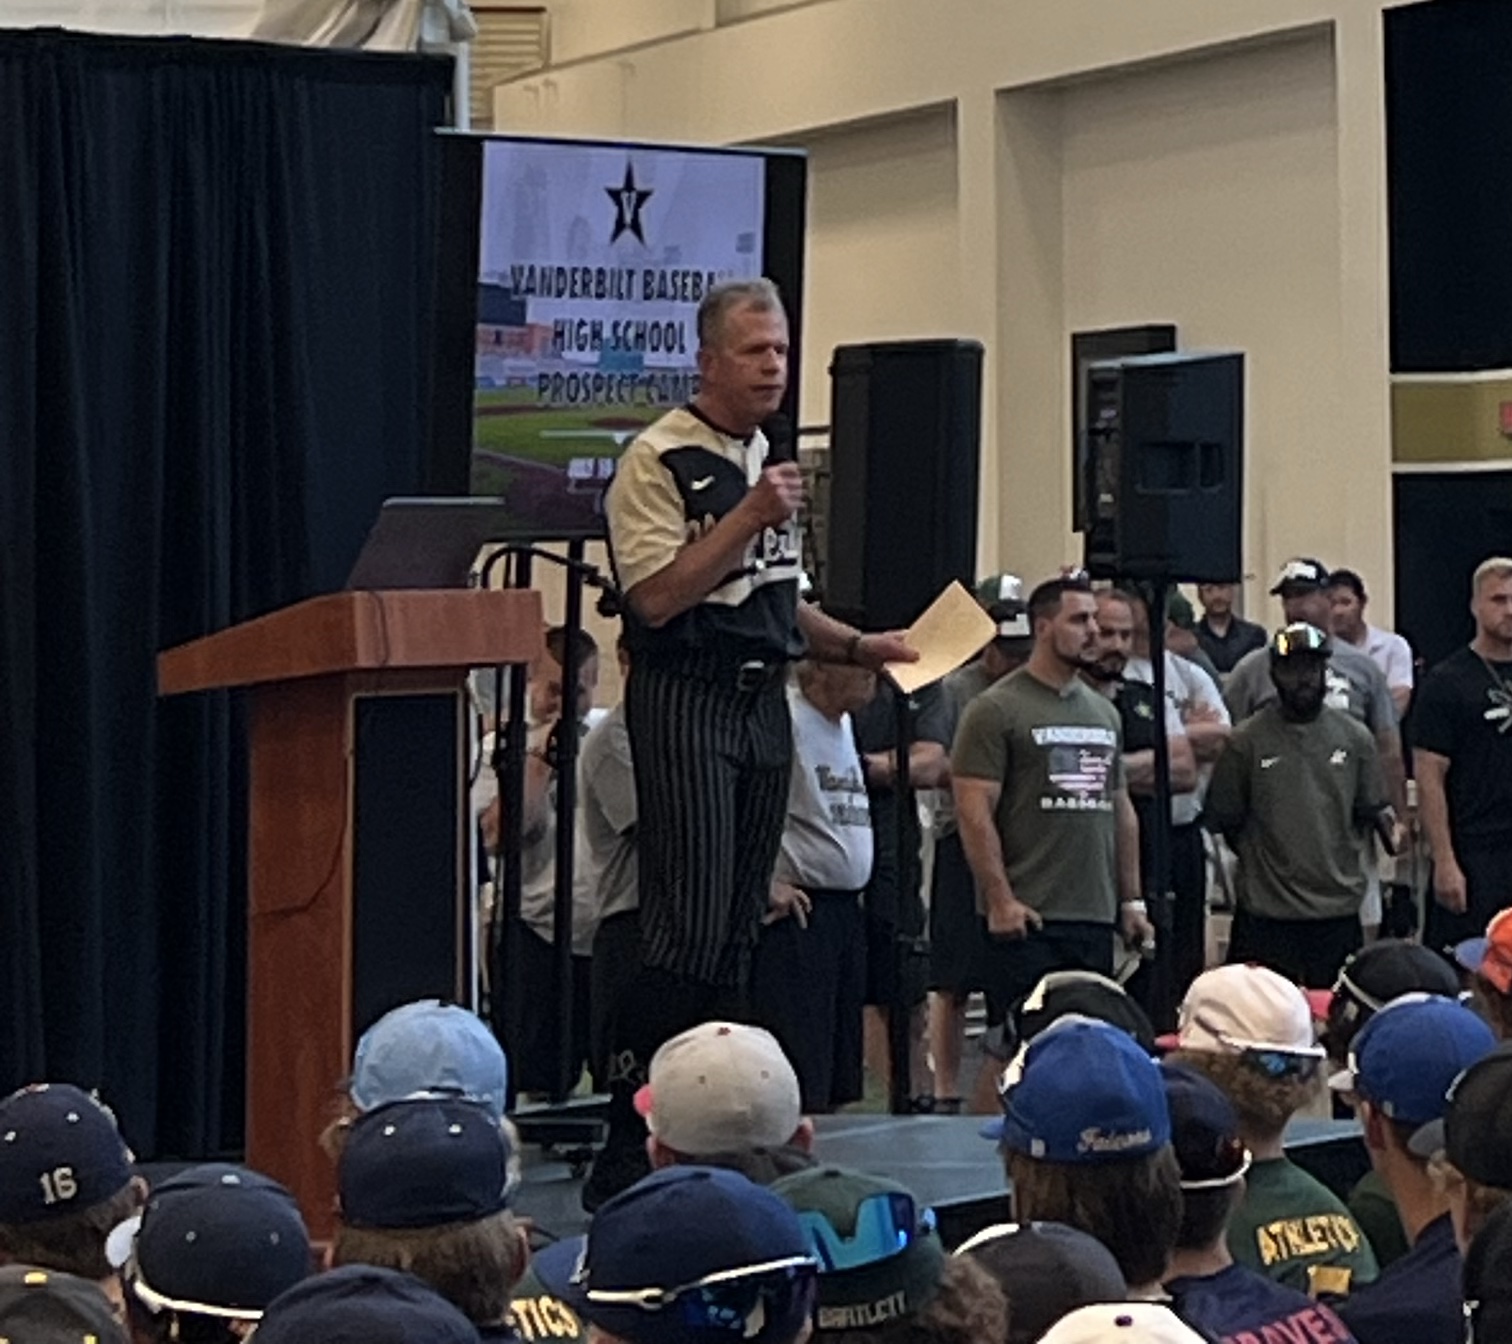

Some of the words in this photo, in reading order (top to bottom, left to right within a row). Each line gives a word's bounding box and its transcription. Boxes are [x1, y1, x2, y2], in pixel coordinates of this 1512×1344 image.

[510, 264, 635, 299] VANDERBILT
[643, 269, 735, 302] BASEBA
[553, 318, 603, 352] HIGH
[612, 319, 686, 354] SCHOOL
[538, 371, 638, 403] PROSPECT
[39, 1166, 78, 1205] 16
